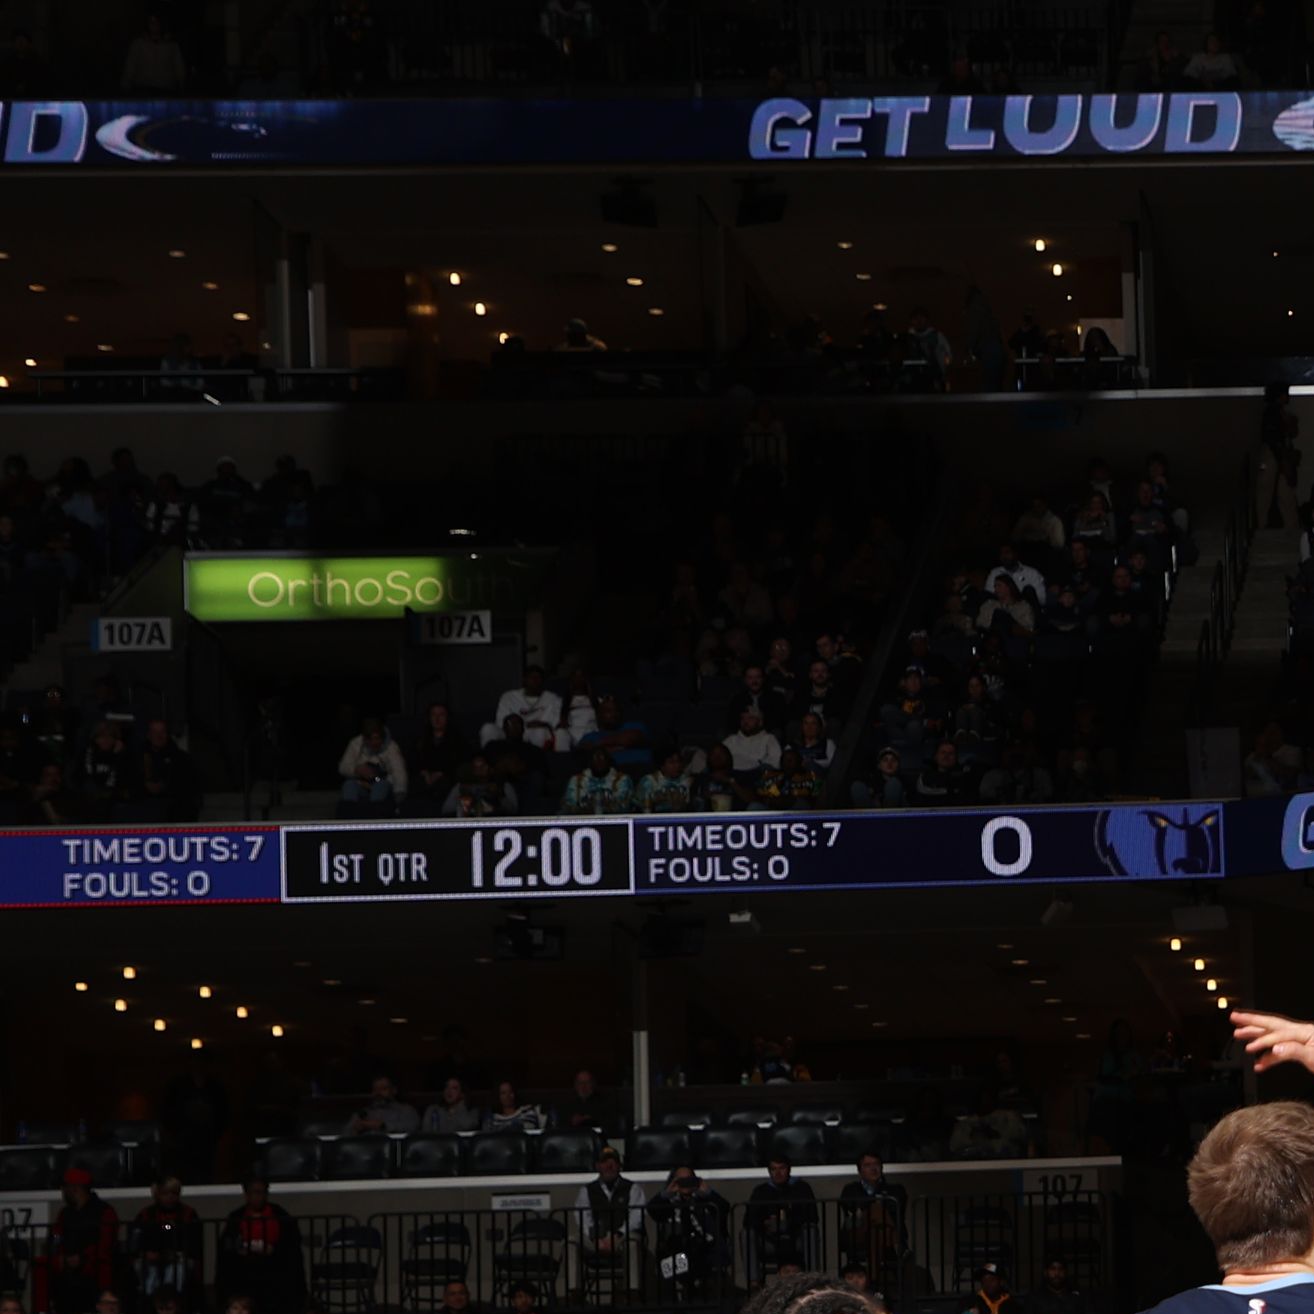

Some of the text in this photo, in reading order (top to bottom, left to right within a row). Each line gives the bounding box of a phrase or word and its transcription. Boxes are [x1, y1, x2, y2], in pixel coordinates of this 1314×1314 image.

[0, 100, 88, 164] D
[747, 91, 1243, 161] GET LOUD
[103, 621, 166, 646] 107A
[425, 614, 486, 639] 107A
[62, 834, 264, 865] TIMEOUTS: 7
[647, 821, 842, 851] TIMEOUTS: 7
[980, 815, 1033, 877] 0
[320, 841, 428, 887] 1ST QTR
[471, 828, 602, 887] 12:00
[648, 857, 759, 883] FOULS:
[62, 871, 179, 899] FOULS:
